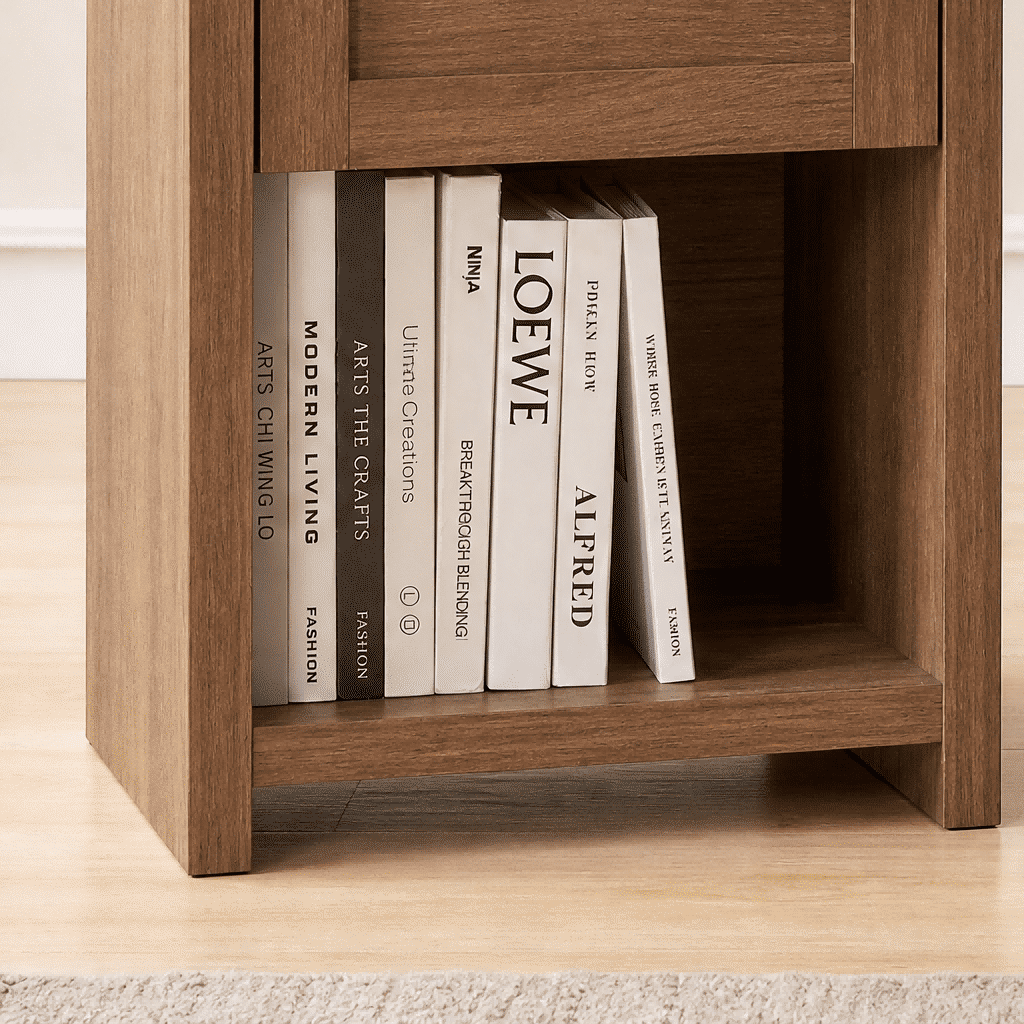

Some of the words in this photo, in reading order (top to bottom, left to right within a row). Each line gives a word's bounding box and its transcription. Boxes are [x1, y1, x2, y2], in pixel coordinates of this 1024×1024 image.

[462, 245, 483, 294] NINJA
[257, 341, 274, 395] ARTS
[353, 339, 369, 395] ARTS
[509, 250, 554, 426] LOEWE
[304, 320, 318, 437] MODERN
[257, 406, 274, 443] CHI
[353, 403, 369, 448] THE
[401, 401, 418, 504] Creations
[257, 450, 274, 507] WING
[304, 453, 319, 544] LIVING
[353, 455, 370, 541] CRAFTS
[257, 515, 275, 540] LO
[571, 485, 597, 628] ALFRED
[306, 606, 318, 684] FASHION
[356, 611, 369, 679] FASHION
